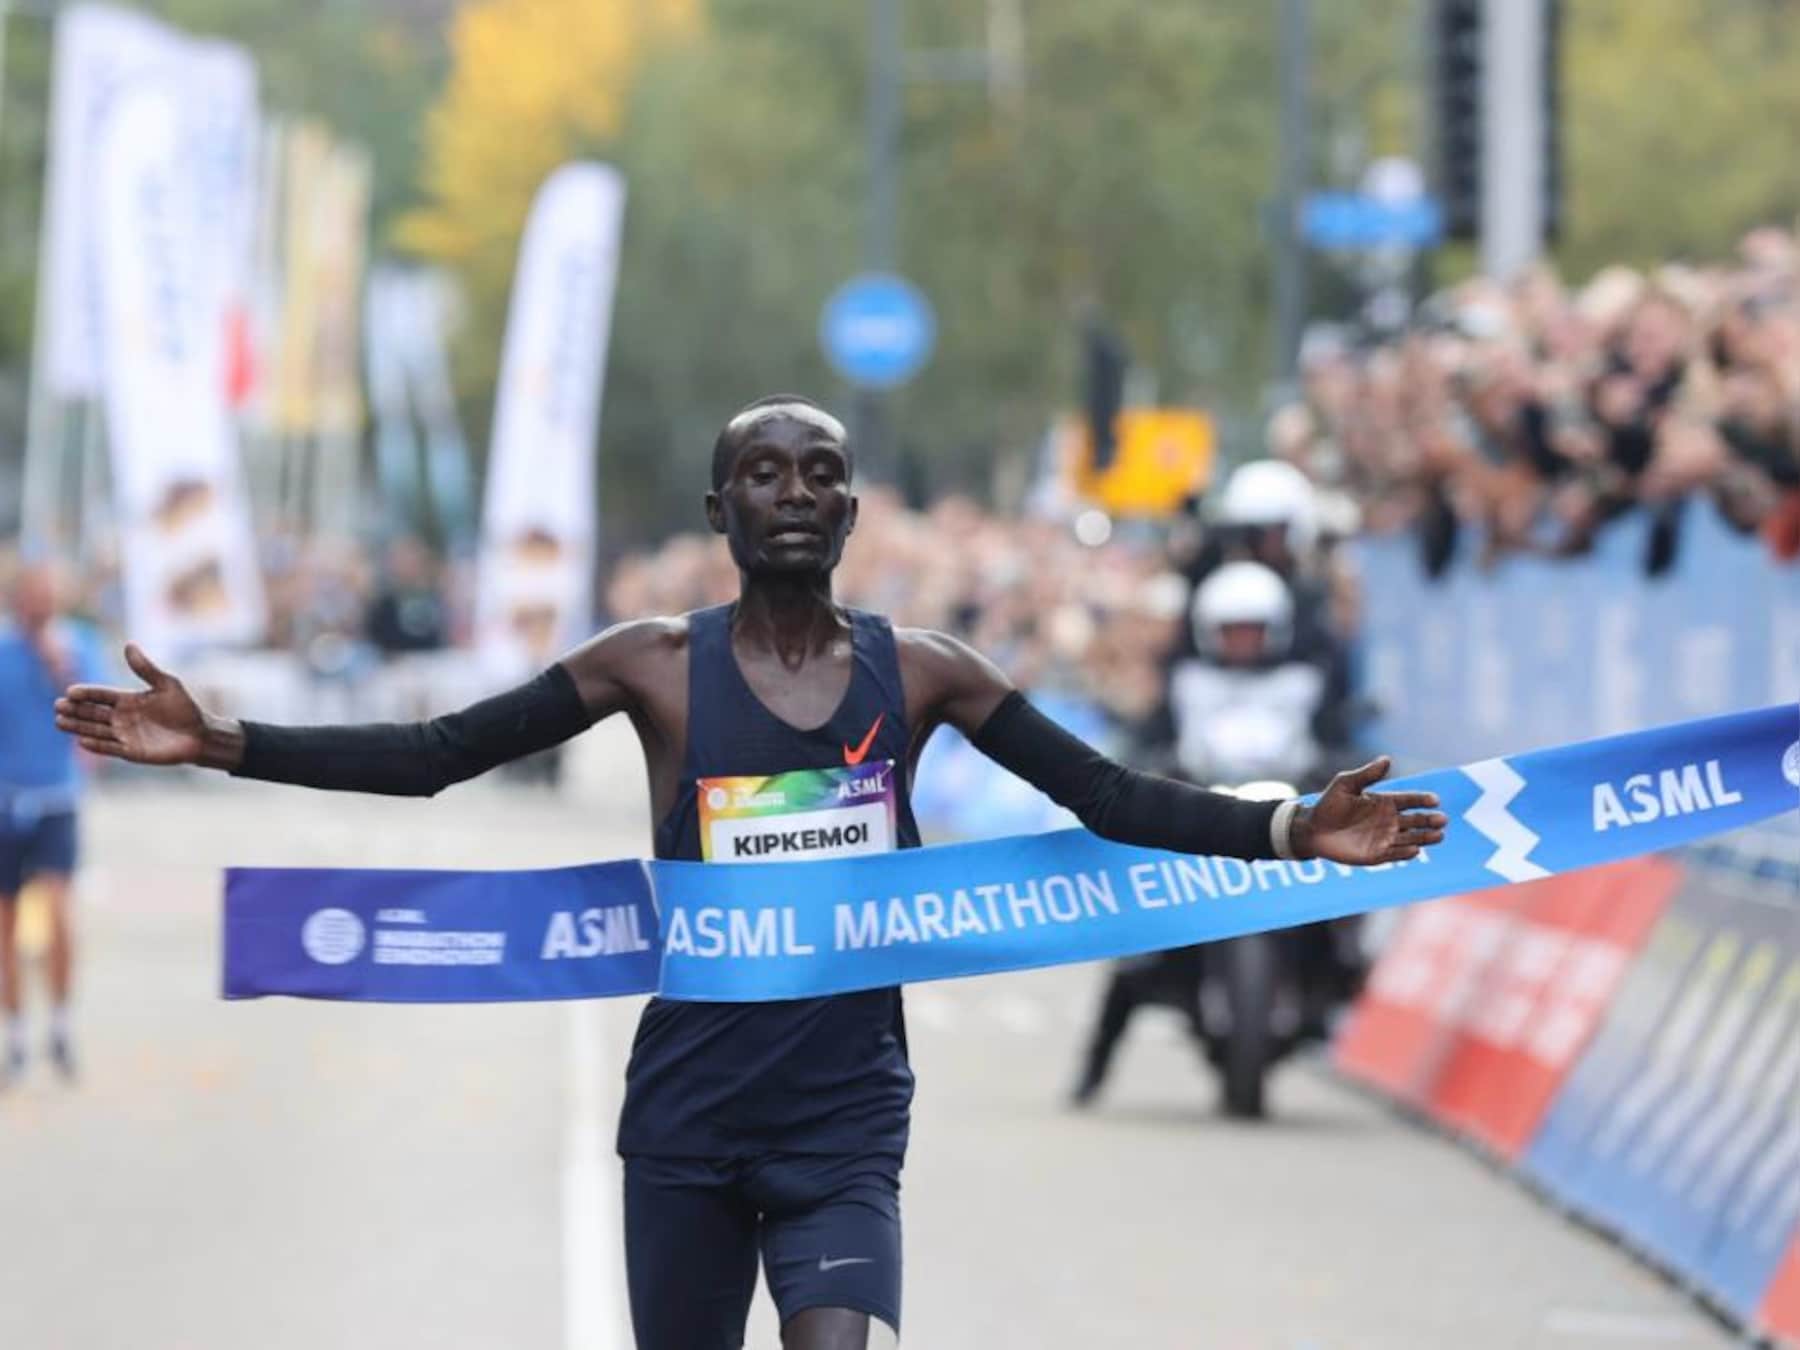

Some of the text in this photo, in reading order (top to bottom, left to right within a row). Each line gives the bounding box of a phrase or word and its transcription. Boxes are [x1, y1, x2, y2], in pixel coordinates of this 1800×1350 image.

[837, 773, 886, 799] ASML
[1592, 759, 1743, 832] ASML
[733, 822, 868, 856] KIPKEMOI
[664, 846, 1430, 958] ASML MARATHON EINDHO
[540, 904, 650, 960] ASML
